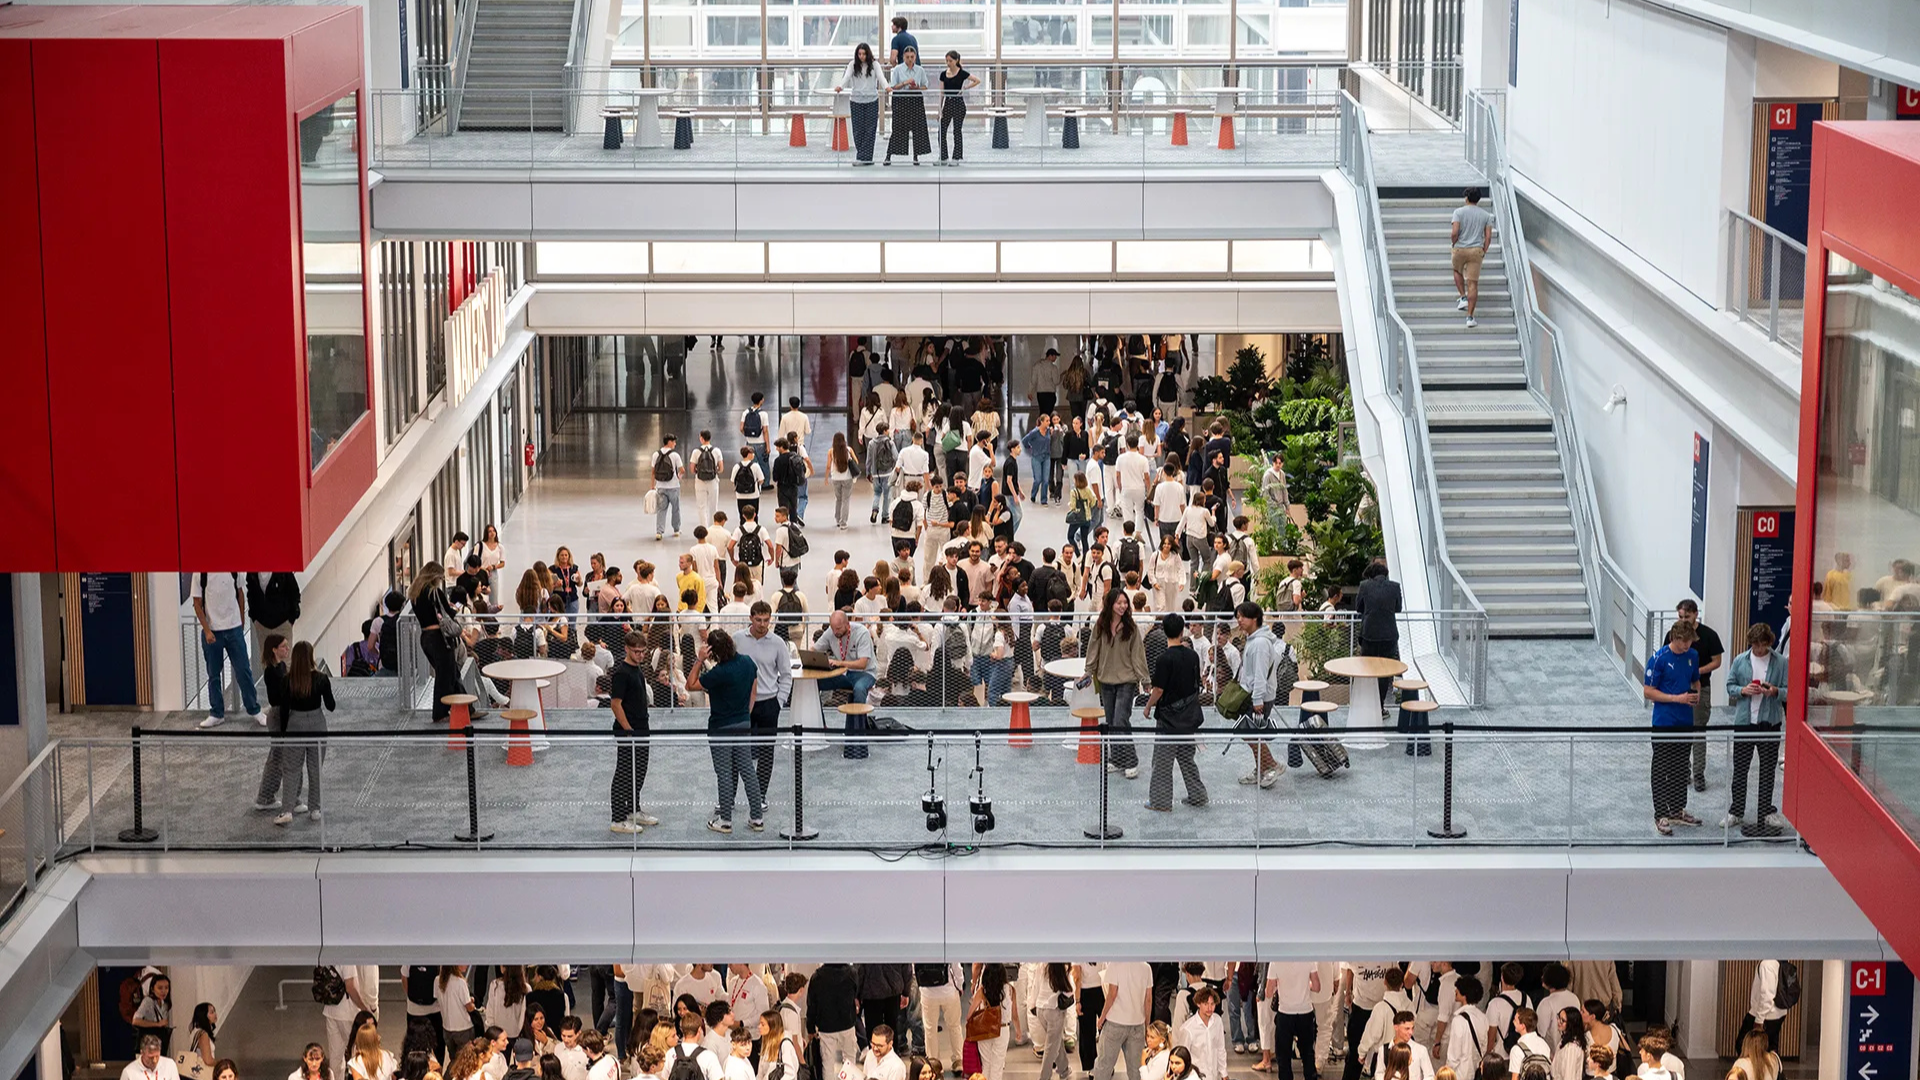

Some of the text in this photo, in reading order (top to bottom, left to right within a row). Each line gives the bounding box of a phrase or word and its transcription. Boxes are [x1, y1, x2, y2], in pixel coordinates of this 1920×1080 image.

[1775, 108, 1791, 125] C1
[1757, 516, 1775, 533] C0
[1855, 968, 1881, 989] C-1
